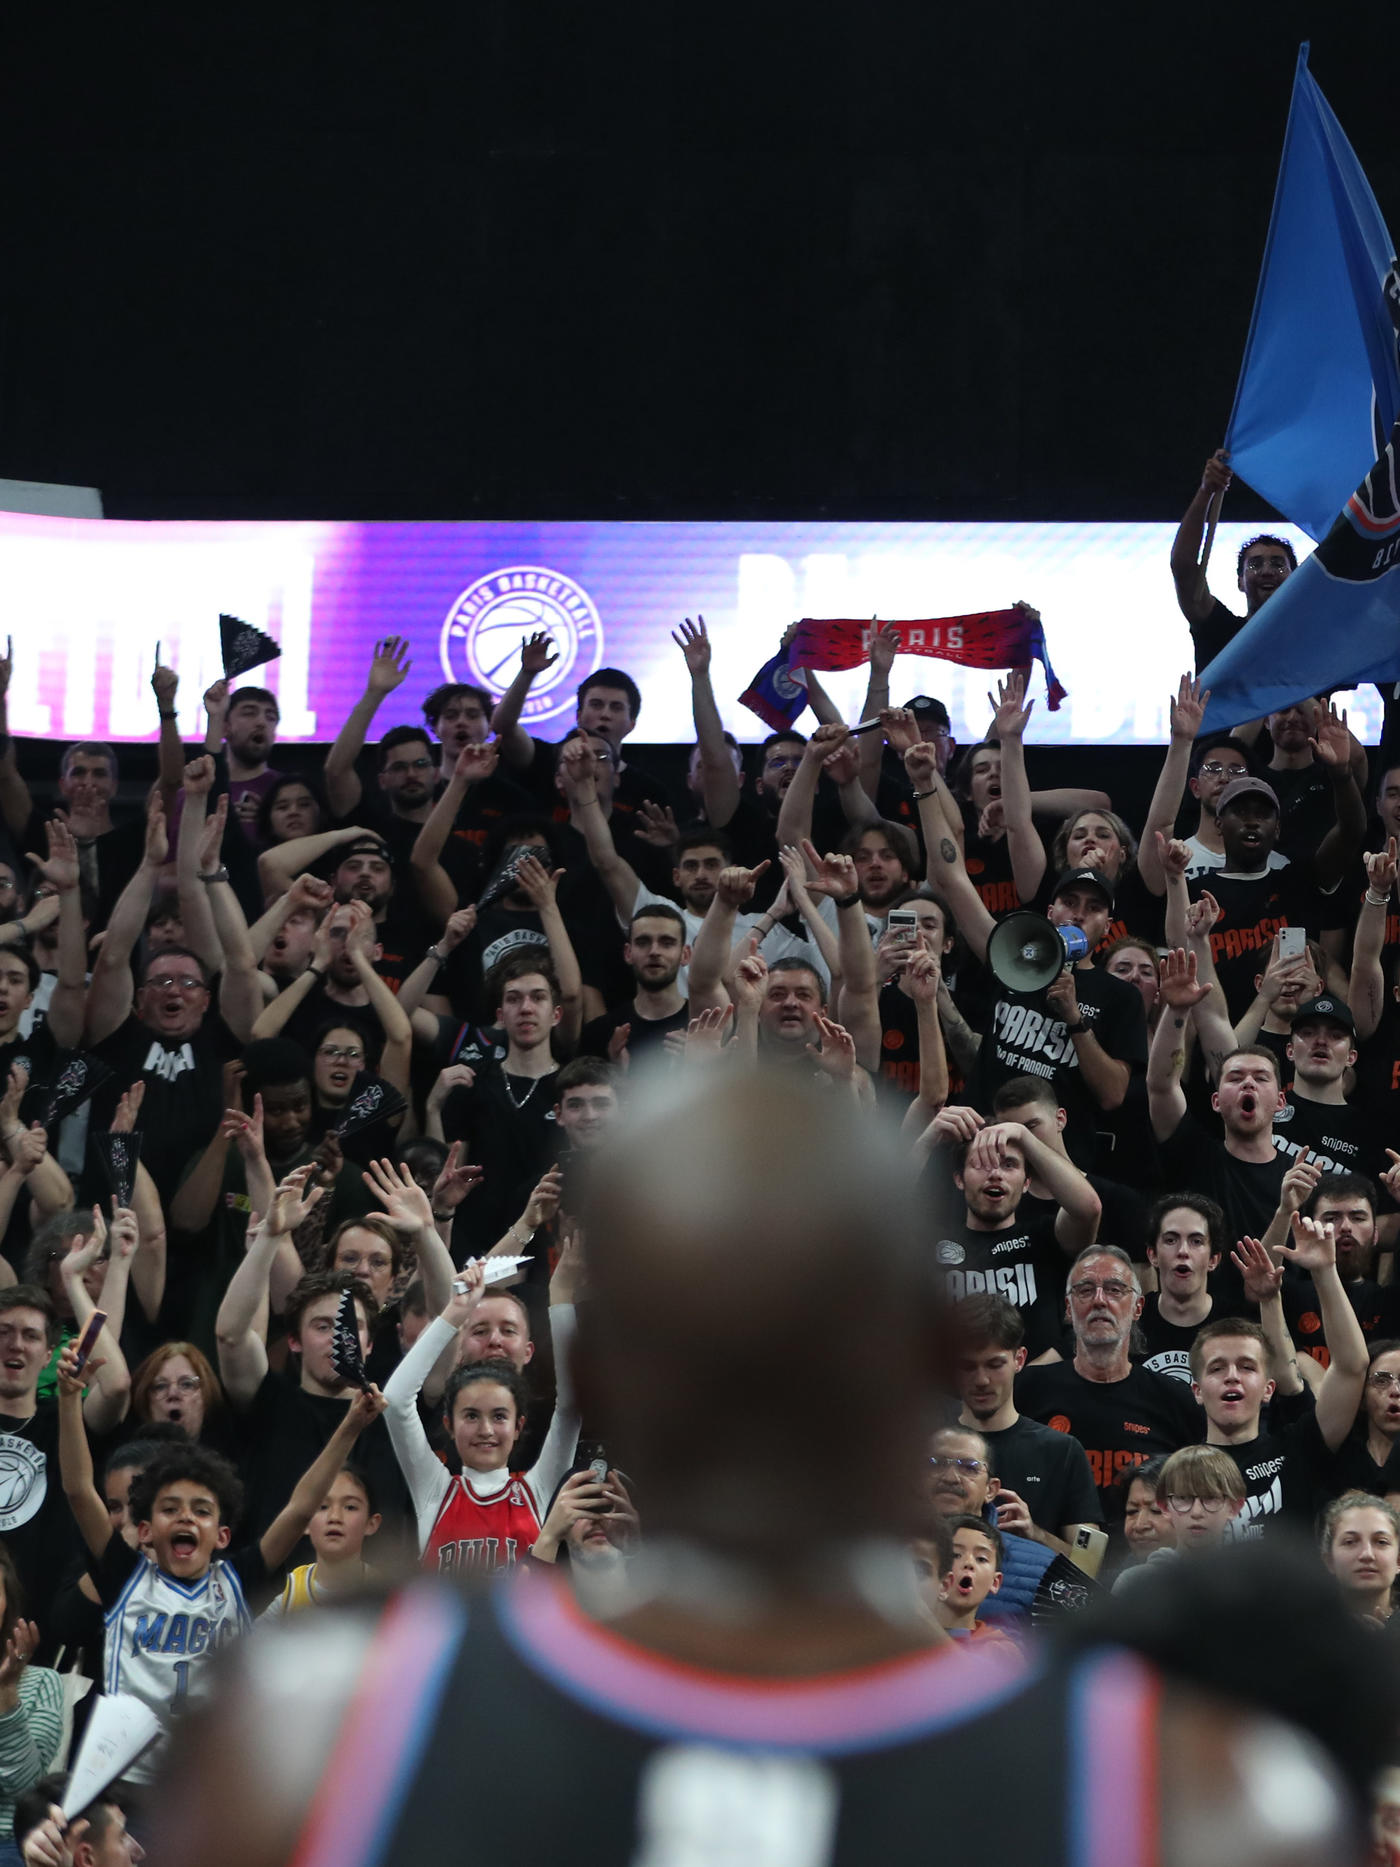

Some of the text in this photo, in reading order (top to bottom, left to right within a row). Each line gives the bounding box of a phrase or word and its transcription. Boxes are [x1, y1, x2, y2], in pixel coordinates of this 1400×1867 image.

[450, 573, 595, 639] PARIS BASKETBALL
[861, 626, 964, 652] PRIS
[1018, 1056, 1057, 1080] PANAME
[1320, 1135, 1359, 1157] snipes
[991, 1236, 1030, 1255] snipes
[1123, 1421, 1151, 1435] snipes
[1245, 1455, 1287, 1482] snipes
[438, 1536, 534, 1577] BULL
